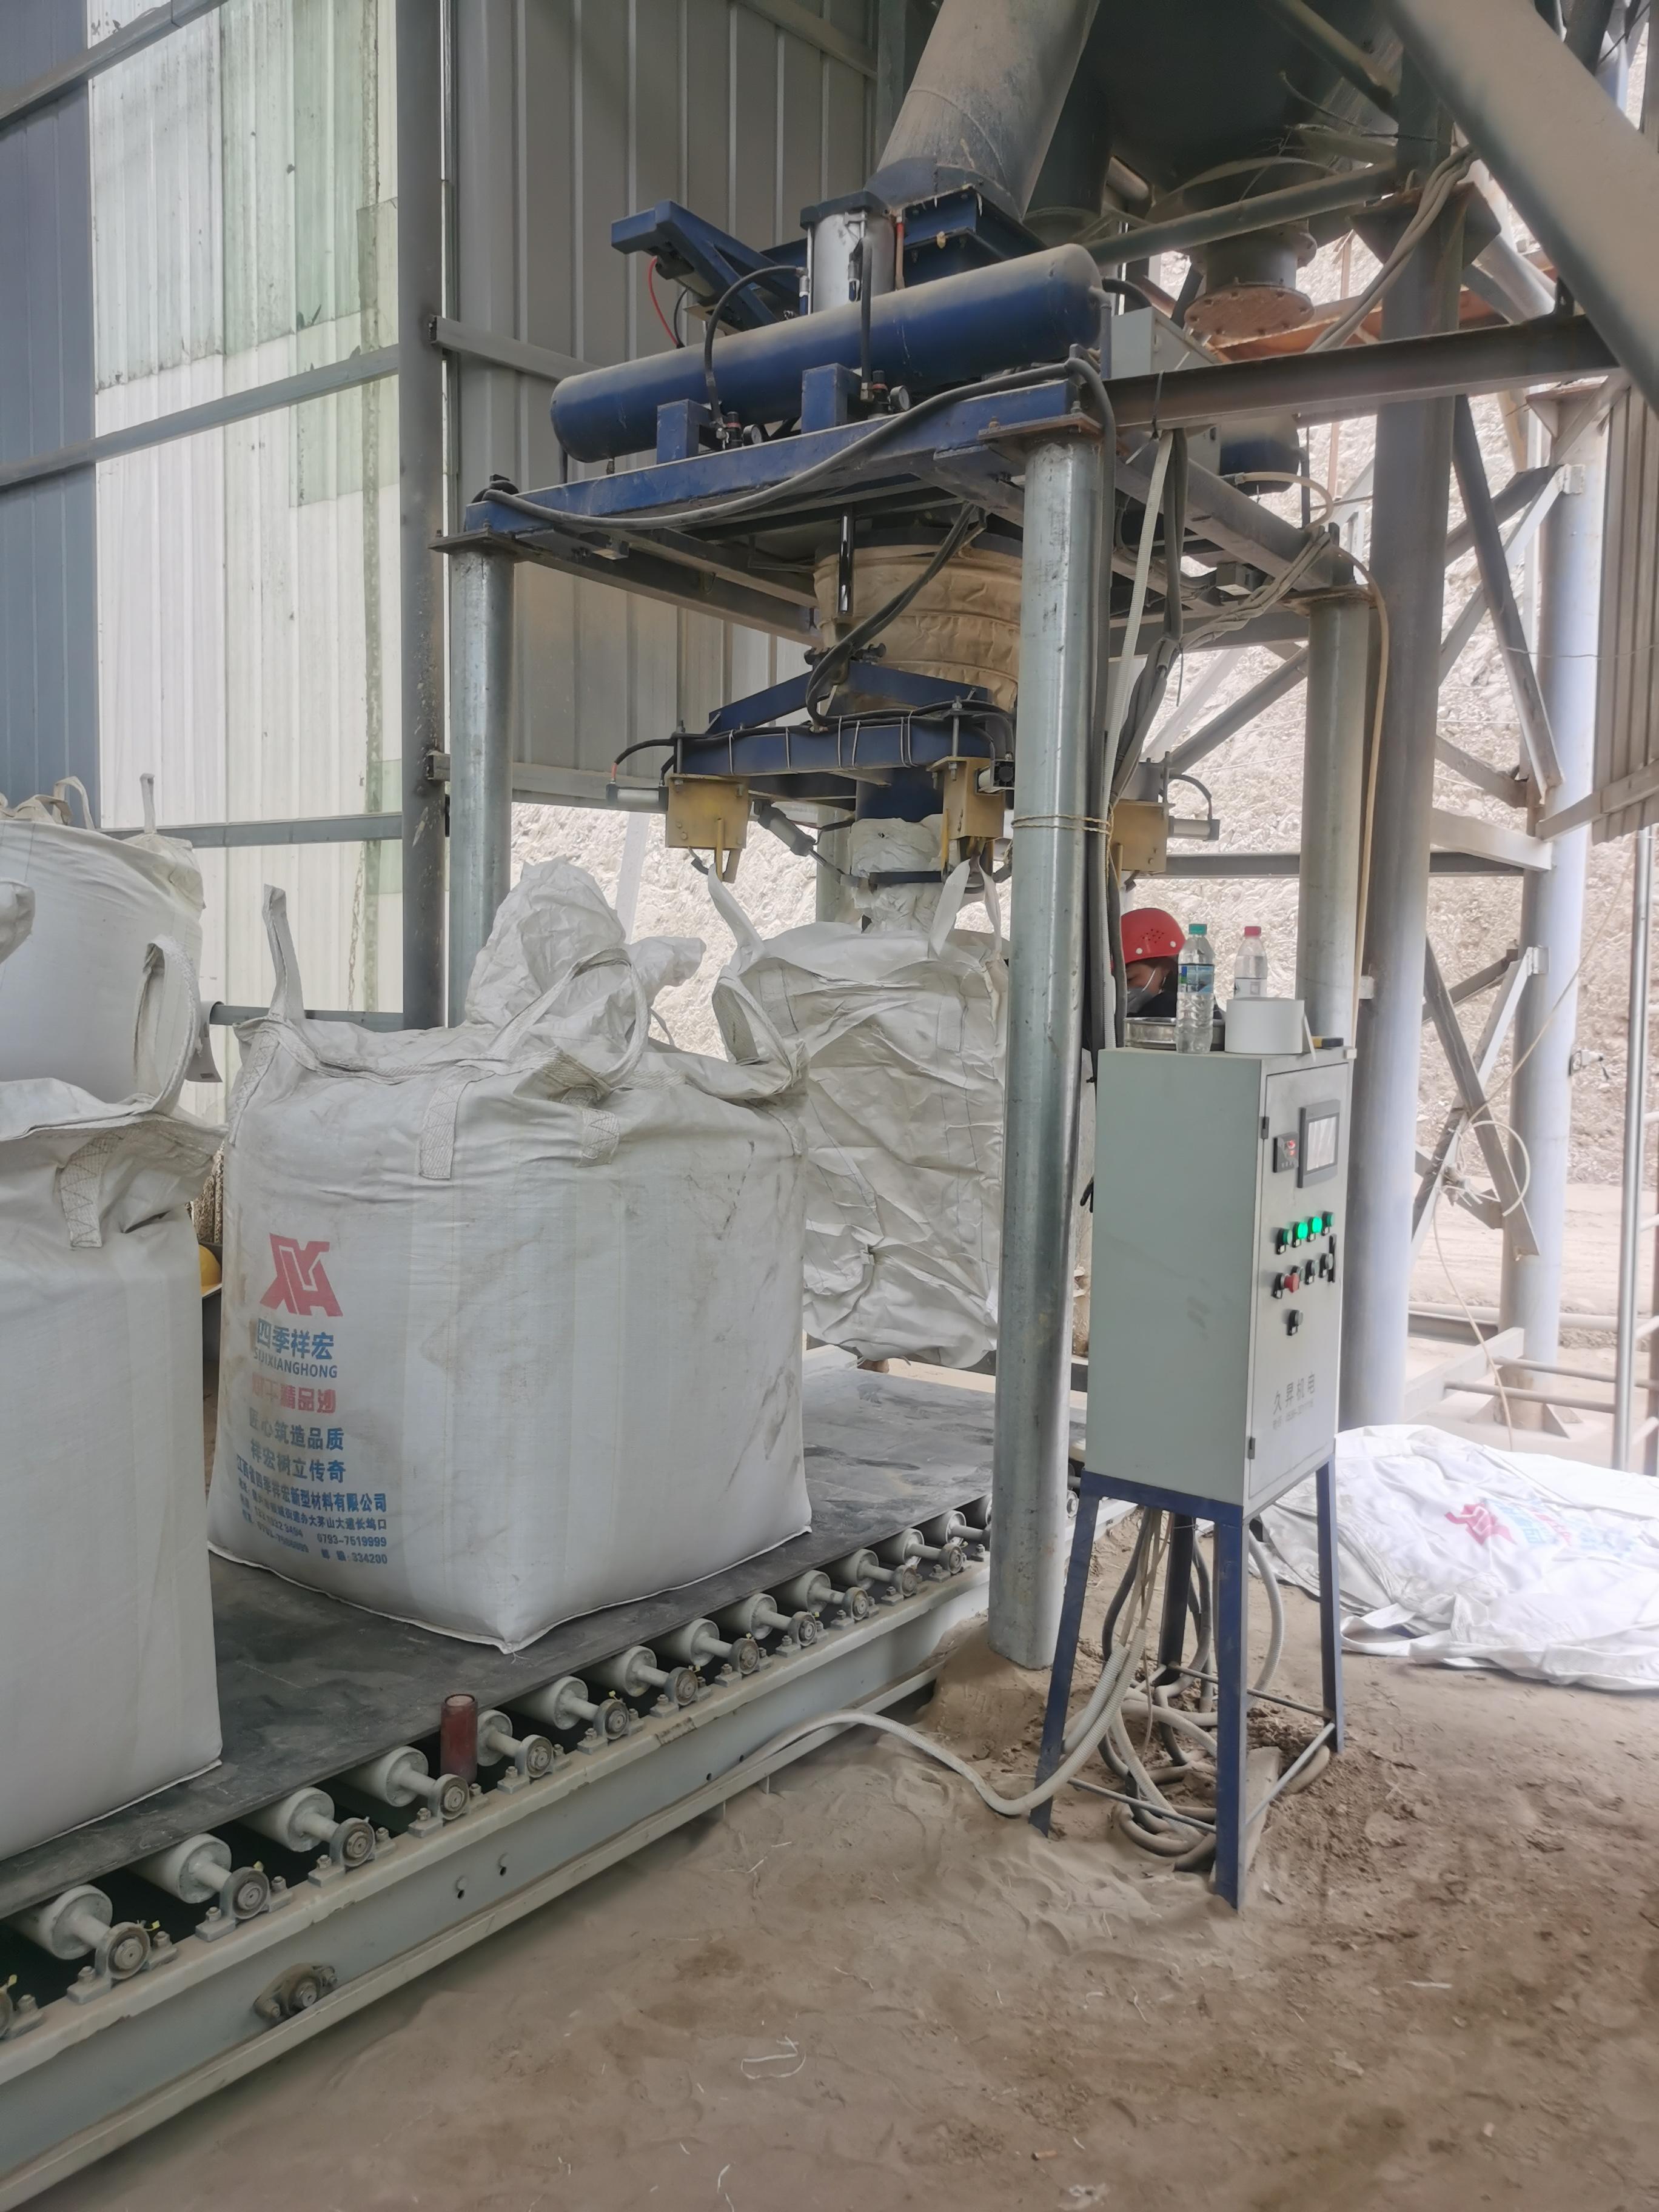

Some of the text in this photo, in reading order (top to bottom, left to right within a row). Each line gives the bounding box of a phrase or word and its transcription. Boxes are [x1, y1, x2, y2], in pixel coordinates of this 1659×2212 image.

[257, 1317, 334, 1359] 四季祥宏
[253, 1347, 338, 1378] SIJIXIANGHONG
[249, 1407, 344, 1450] 匠心筑造品质
[250, 1438, 346, 1483] 祥宏树立传奇
